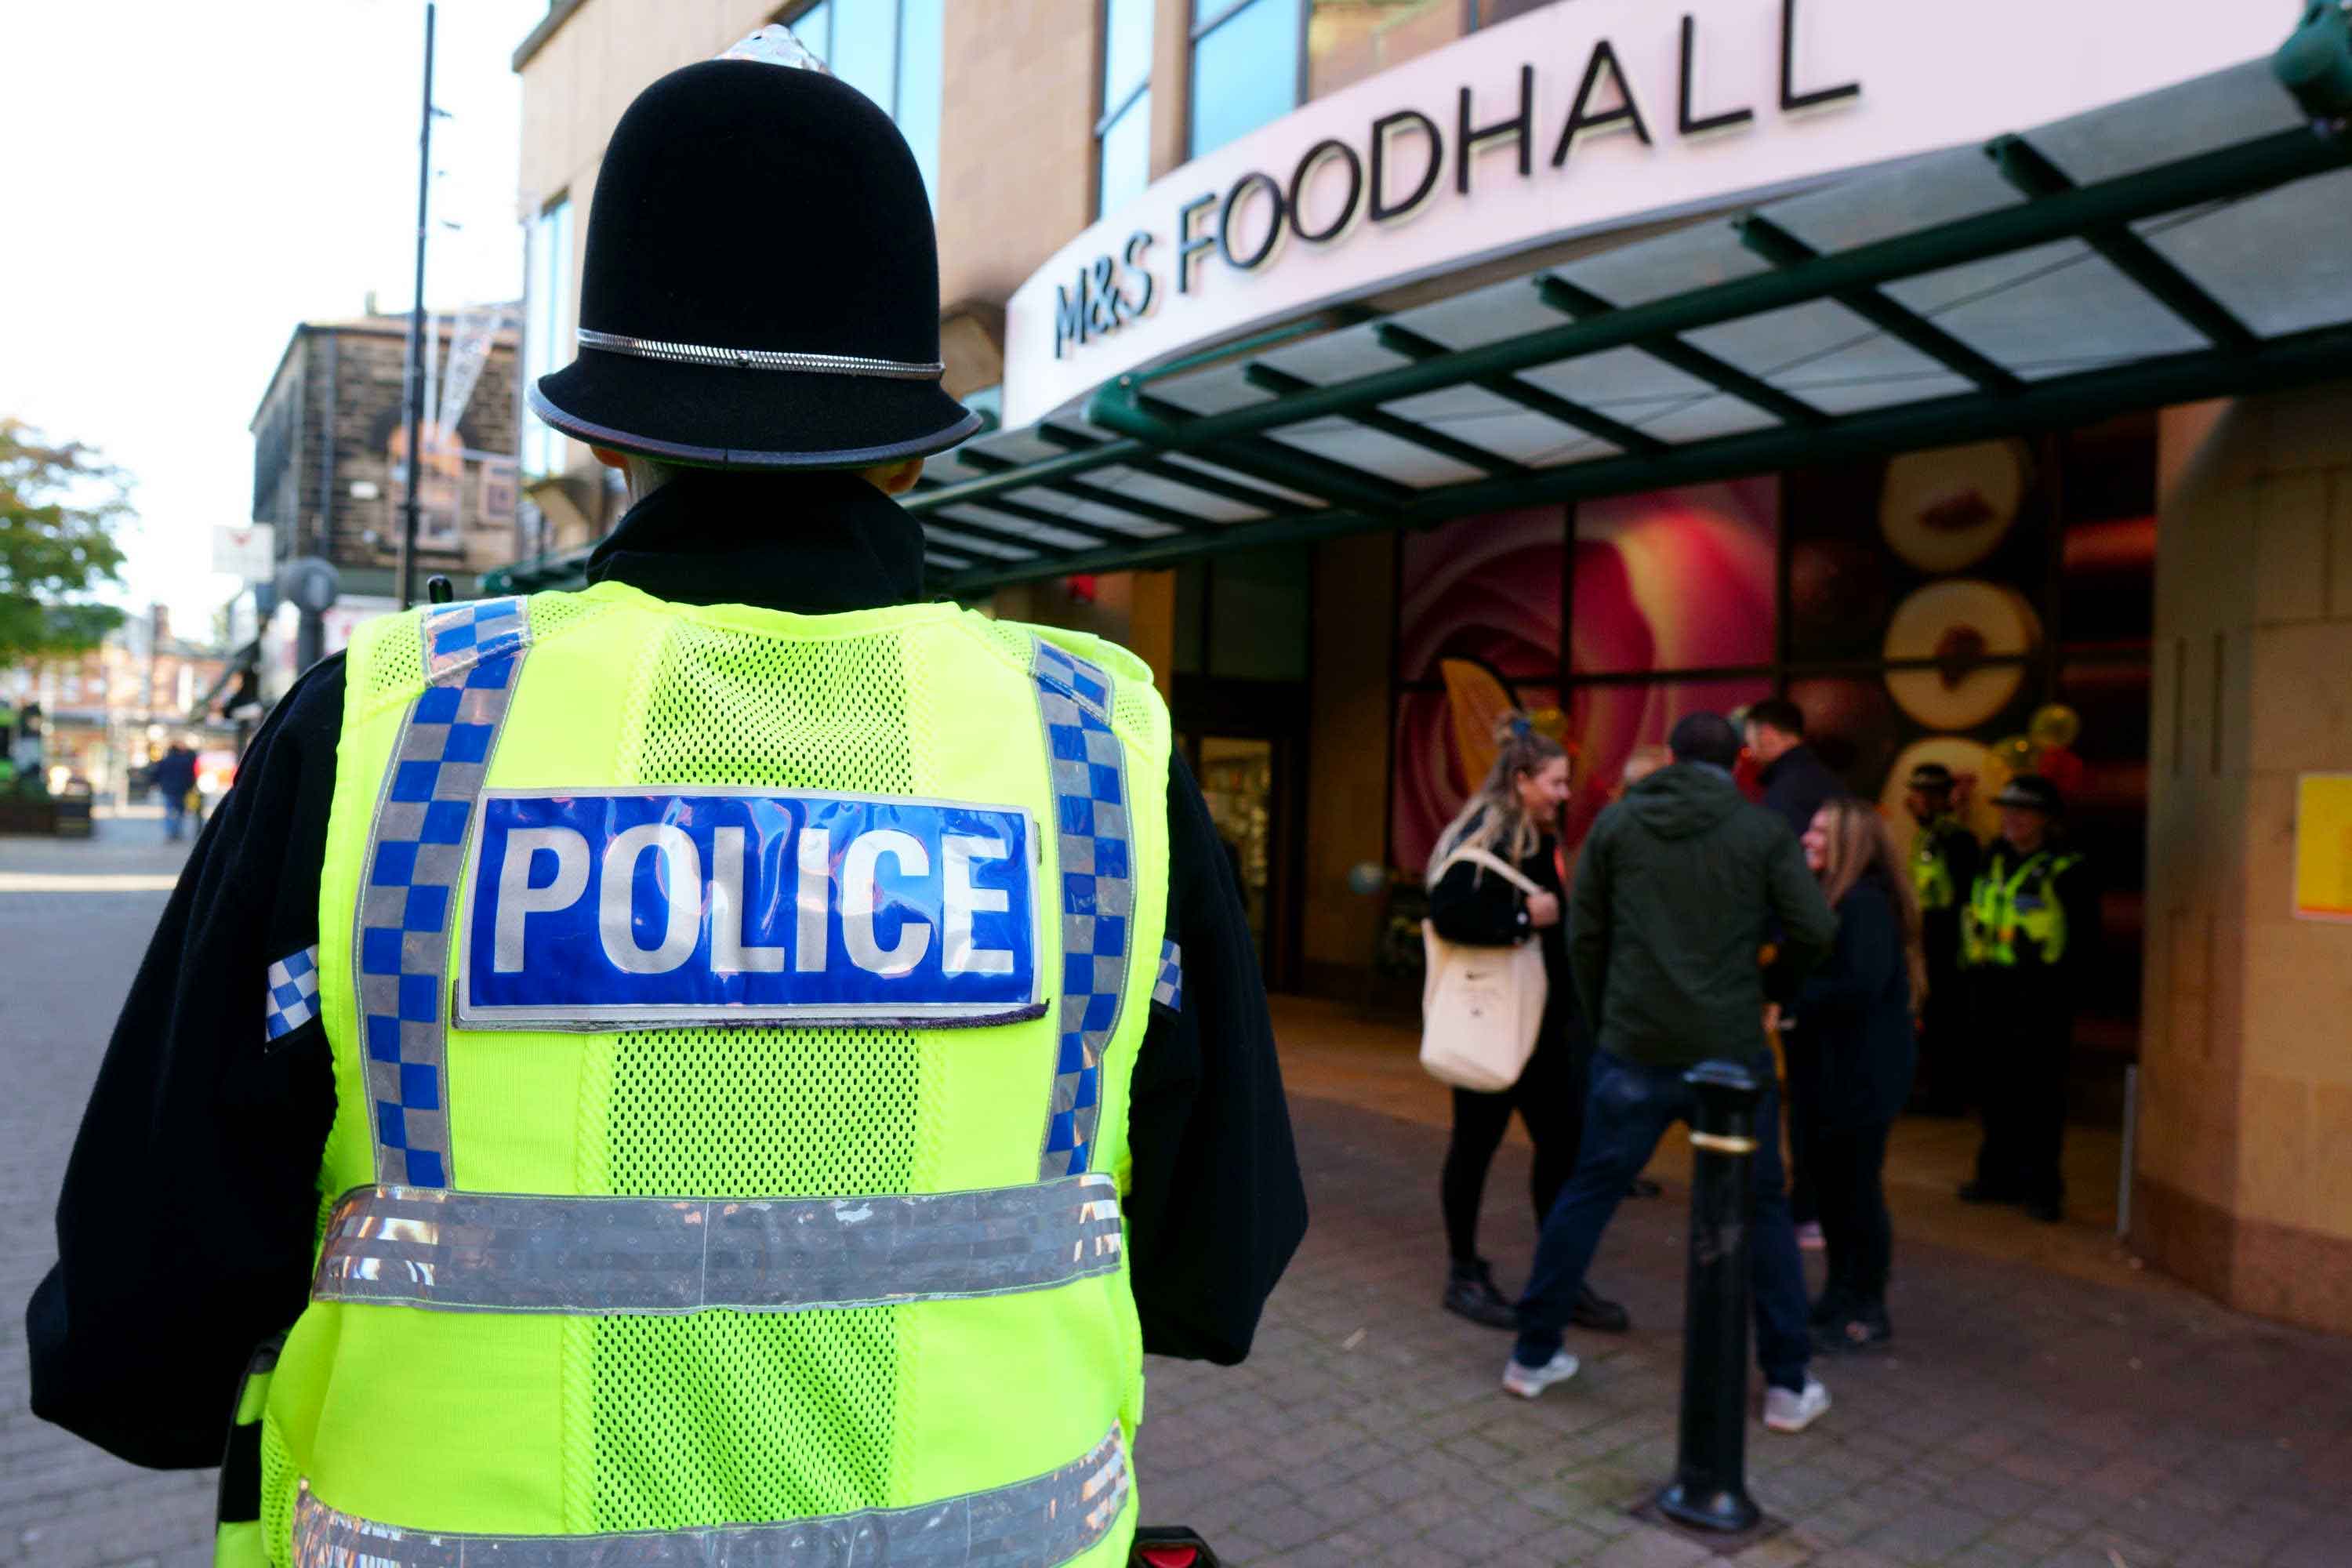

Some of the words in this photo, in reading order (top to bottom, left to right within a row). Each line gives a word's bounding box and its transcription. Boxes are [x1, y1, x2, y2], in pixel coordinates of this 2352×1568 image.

[1055, 230, 1153, 359] M&S
[1178, 0, 1860, 293] FOODHALL
[493, 822, 1014, 975] POLICE
